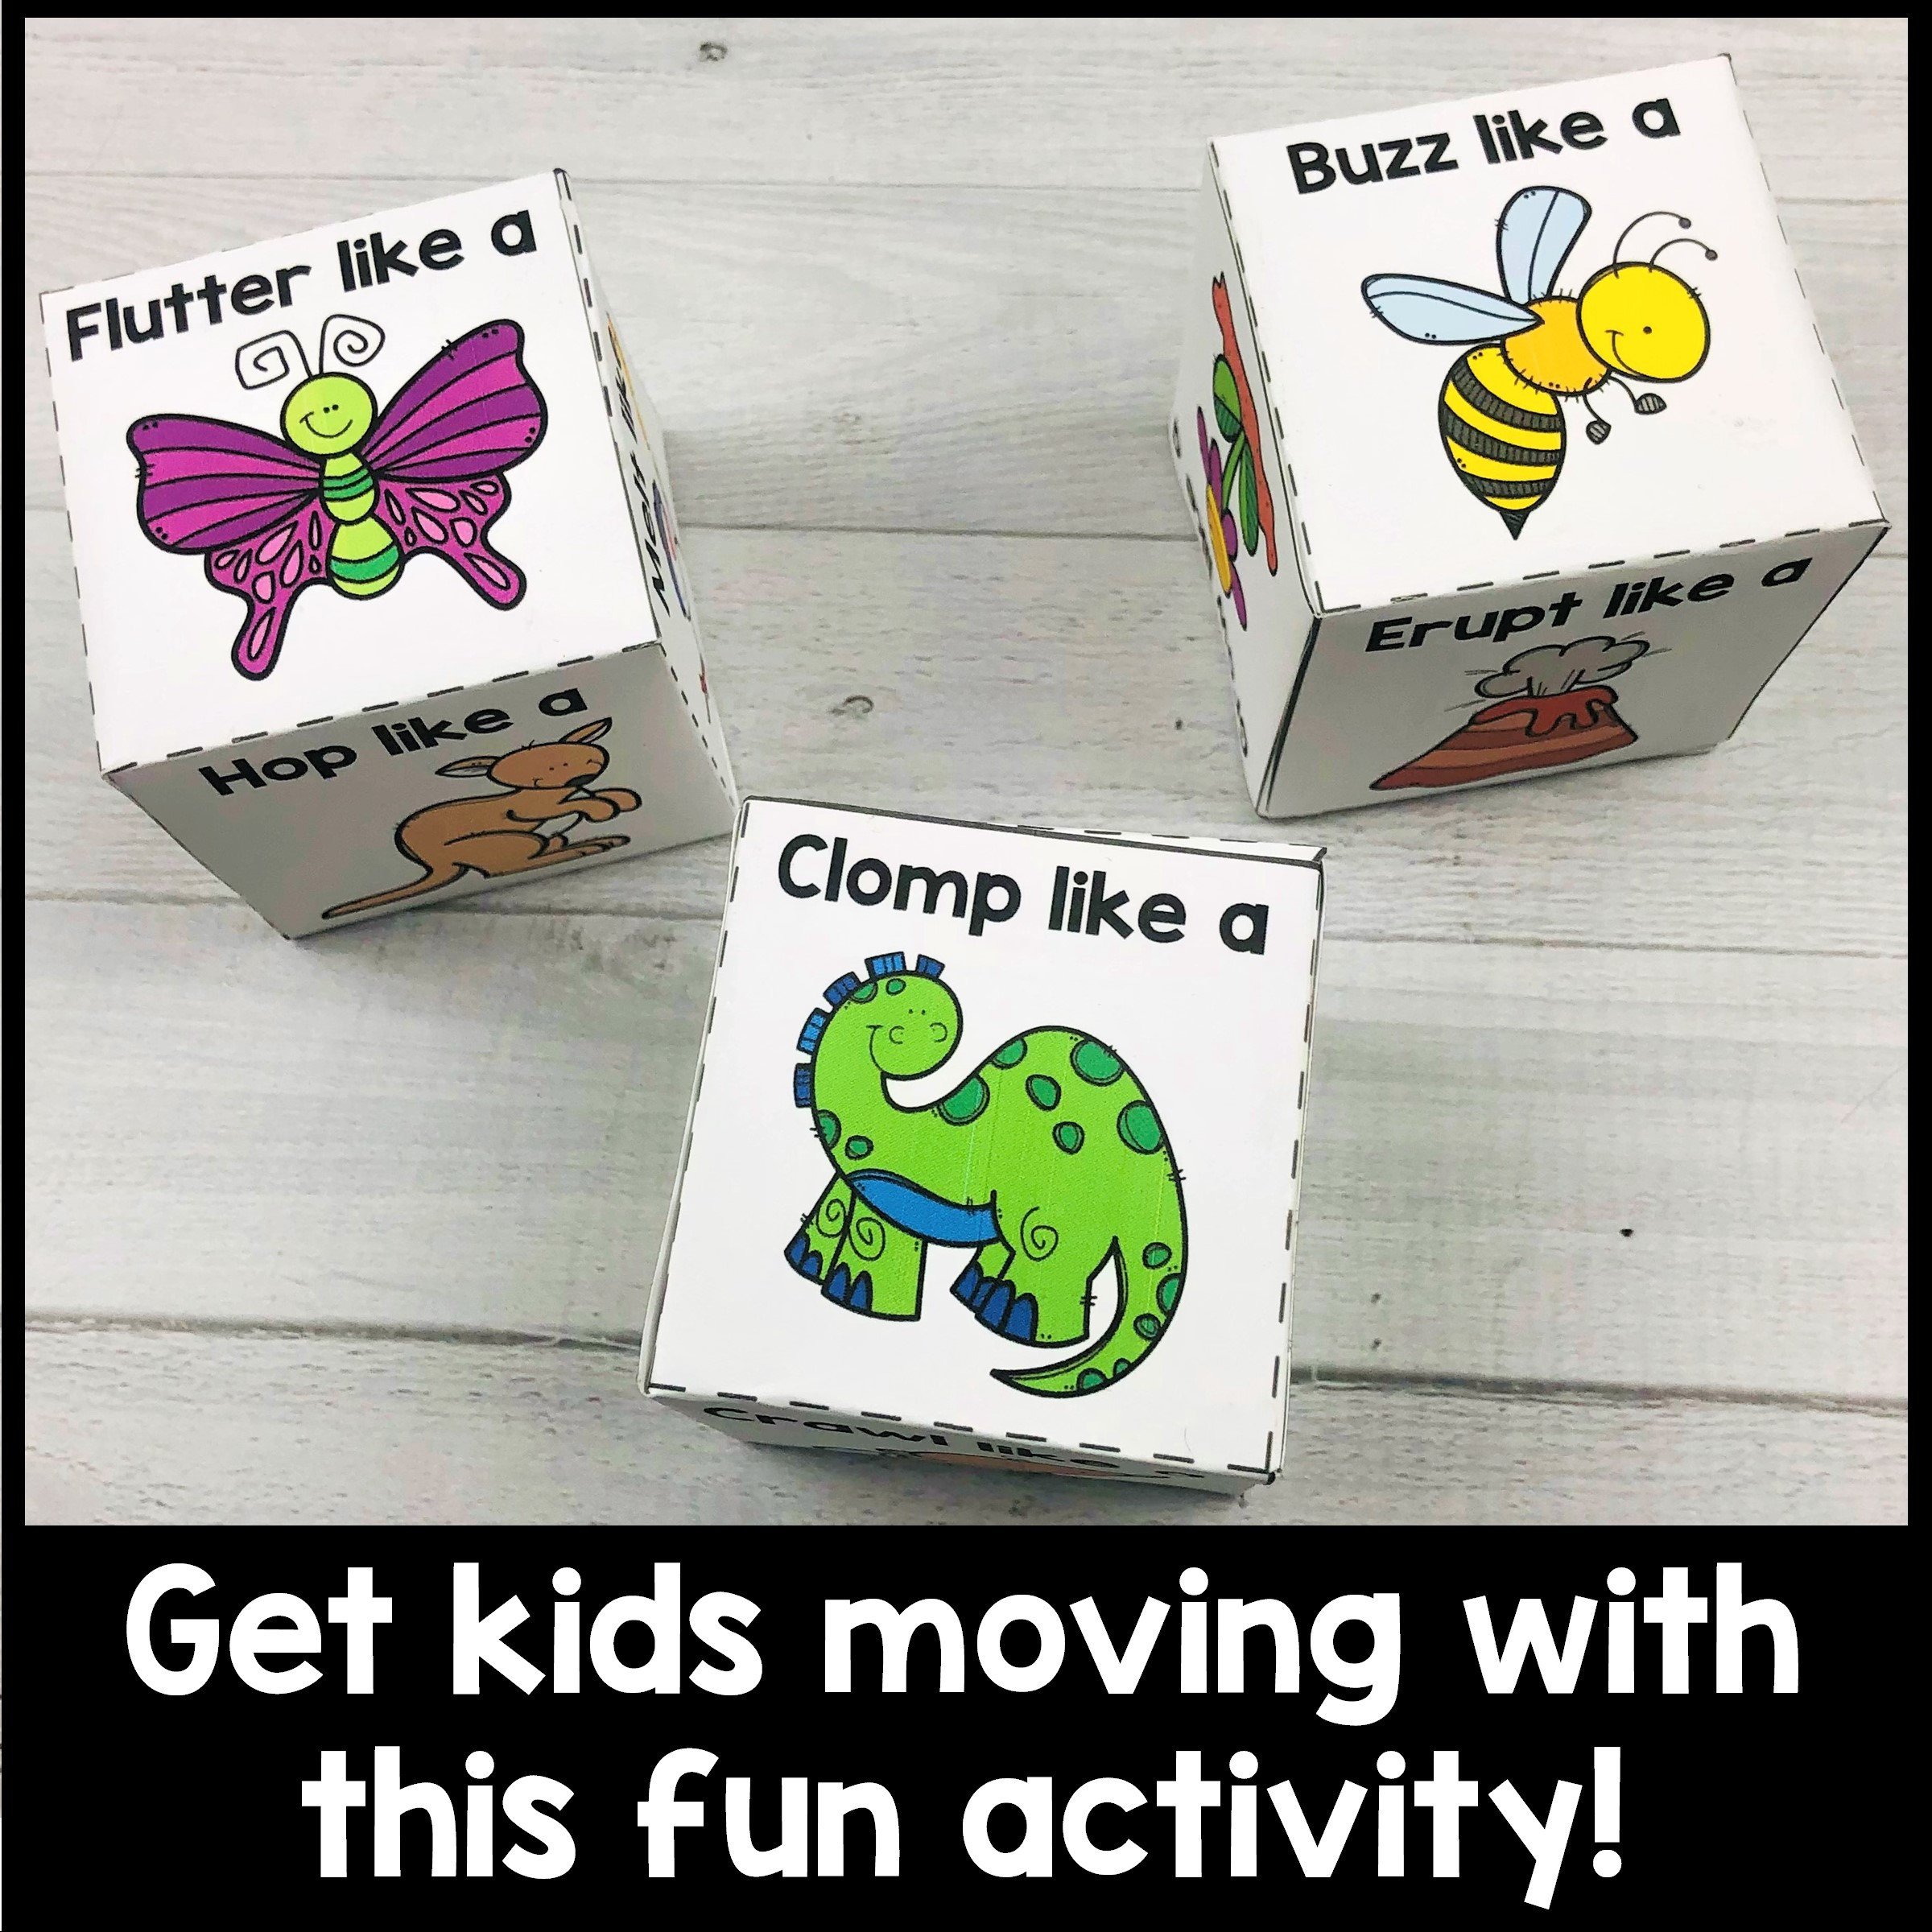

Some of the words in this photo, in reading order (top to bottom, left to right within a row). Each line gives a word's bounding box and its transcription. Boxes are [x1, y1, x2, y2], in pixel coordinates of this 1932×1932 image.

[1286, 132, 1459, 194] Buzz
[1472, 109, 1608, 164] like
[1632, 97, 1681, 138] a
[66, 265, 312, 361] Flutter
[336, 229, 464, 292] like
[490, 209, 537, 257] a
[1364, 591, 1583, 653] Erupt
[1602, 573, 1736, 619] like
[1761, 556, 1814, 588] a
[197, 745, 357, 797] Hop
[370, 708, 515, 757] like
[538, 687, 588, 717] a
[778, 833, 1022, 937] Clomp
[1048, 865, 1187, 943] like
[1219, 902, 1269, 956] a
[703, 1407, 949, 1446] Crawl
